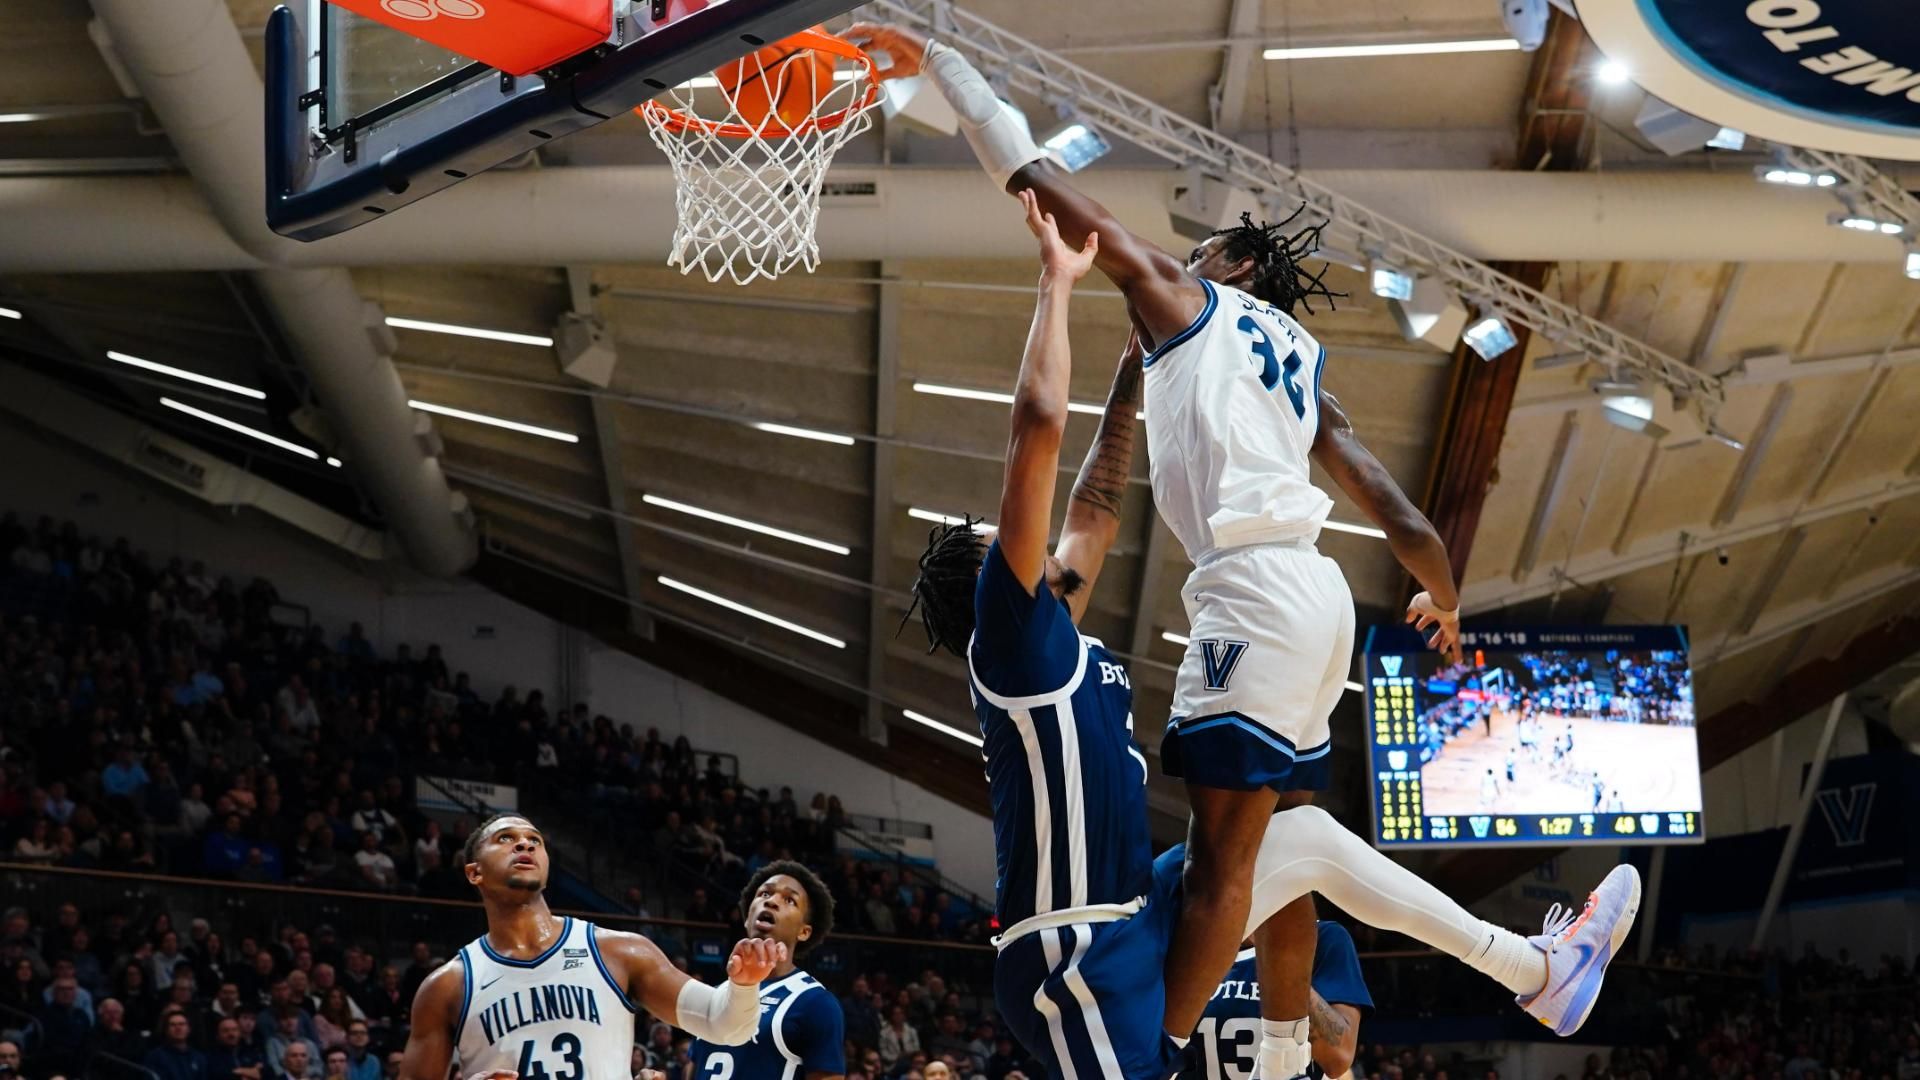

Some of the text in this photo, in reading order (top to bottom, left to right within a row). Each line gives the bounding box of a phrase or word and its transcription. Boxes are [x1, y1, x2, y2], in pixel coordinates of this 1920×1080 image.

[1746, 0, 1920, 103] ME TO
[1199, 640, 1249, 691] V
[1496, 818, 1517, 836] 56
[1539, 817, 1573, 835] 1:27
[479, 984, 602, 1046] VILLANOVA
[517, 1032, 585, 1080] 43
[1197, 1017, 1262, 1080] 13
